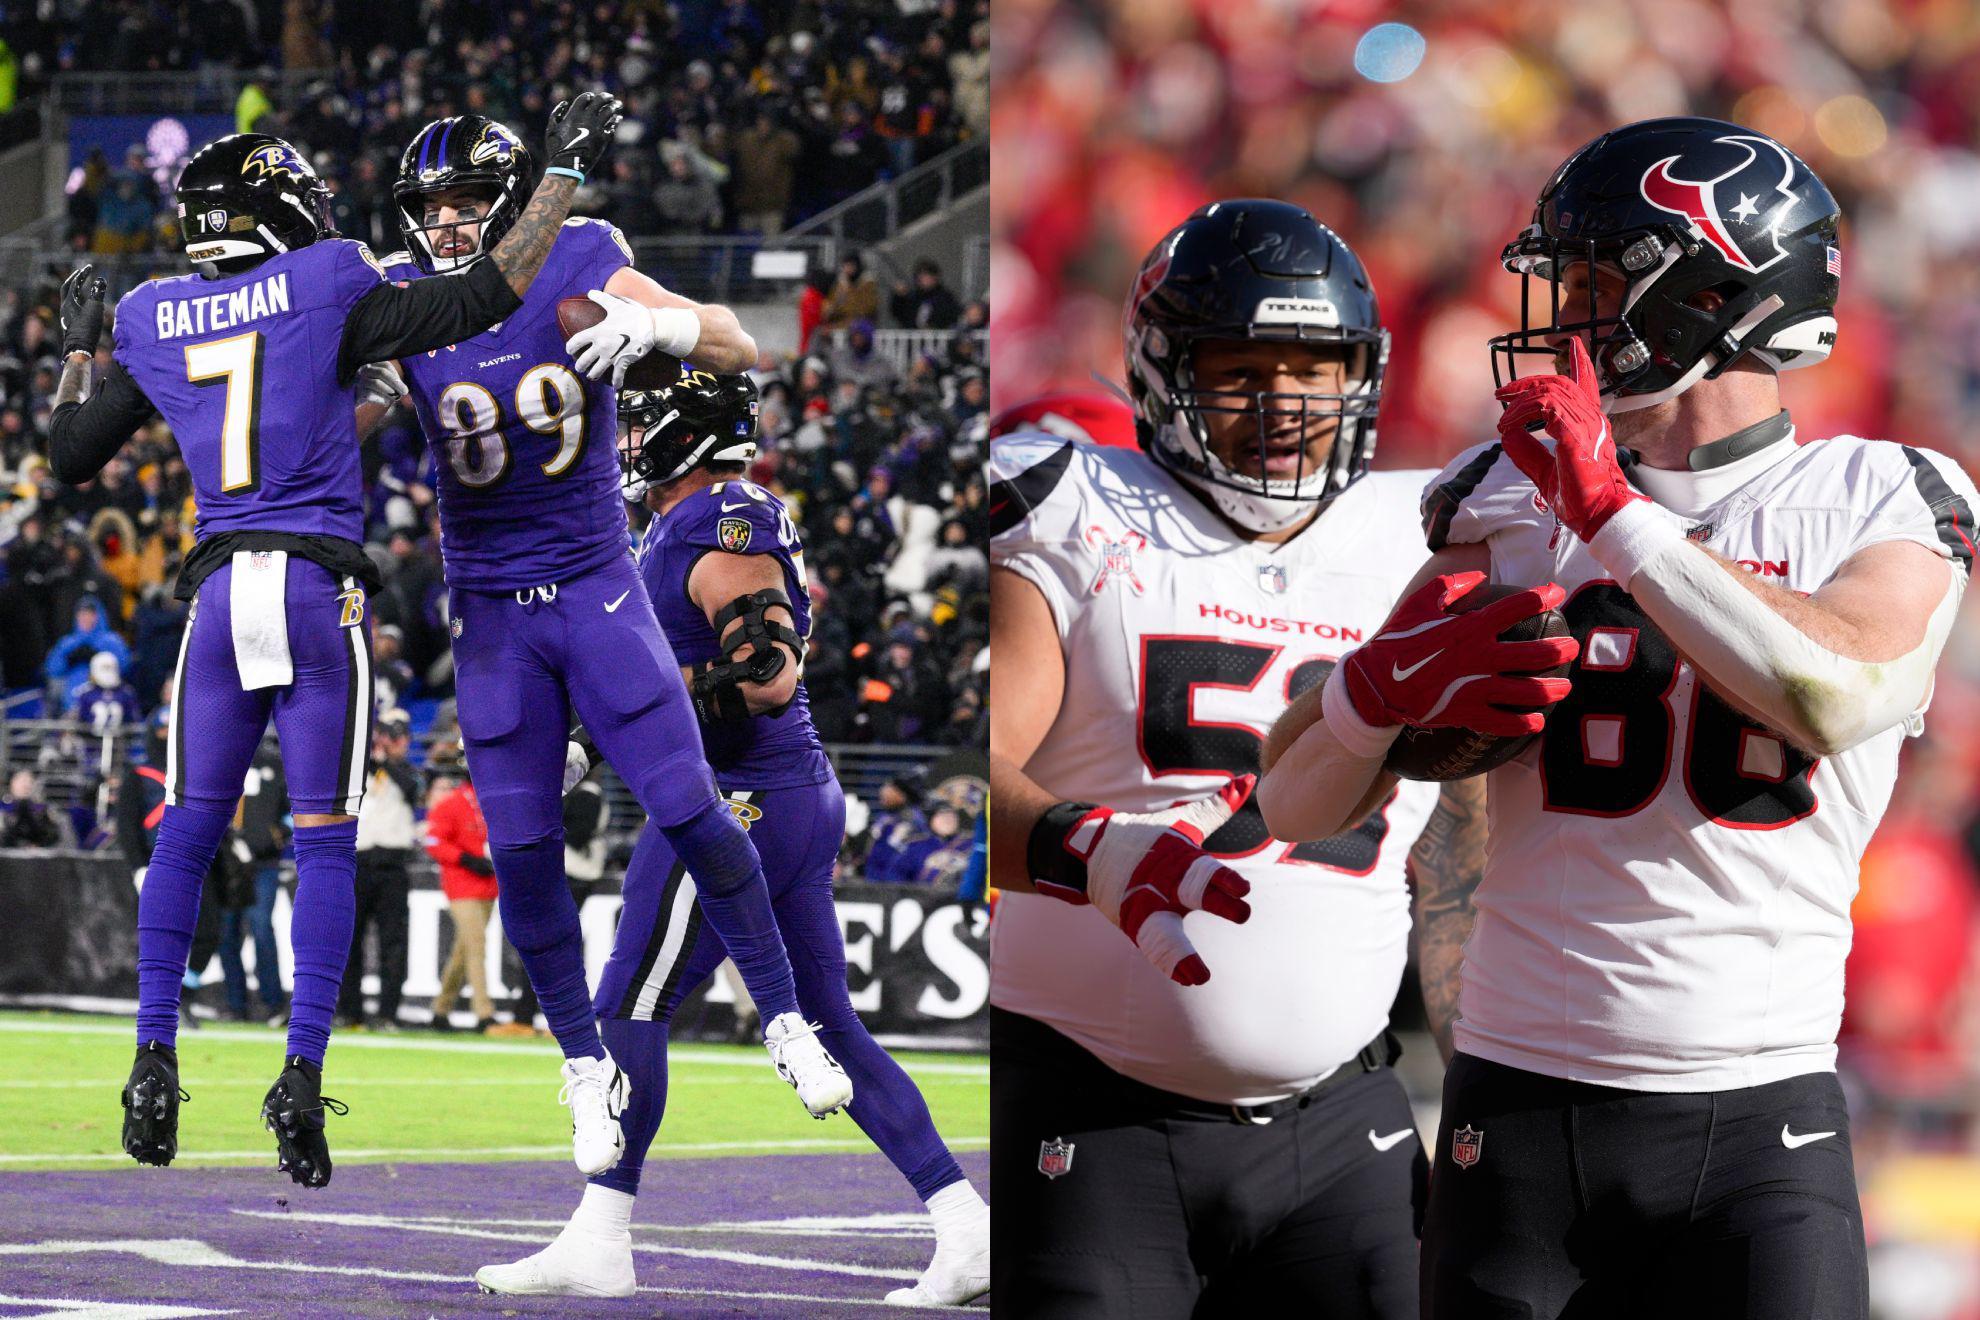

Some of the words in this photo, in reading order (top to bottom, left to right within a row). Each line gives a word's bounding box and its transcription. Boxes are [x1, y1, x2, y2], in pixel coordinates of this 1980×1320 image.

[157, 274, 290, 340] BATEMAN
[1265, 304, 1329, 312] TEXANS
[478, 353, 521, 368] RAVENS
[184, 330, 262, 494] 7
[438, 362, 586, 488] 89
[334, 588, 365, 628] B
[1199, 604, 1362, 643] HOUSTON
